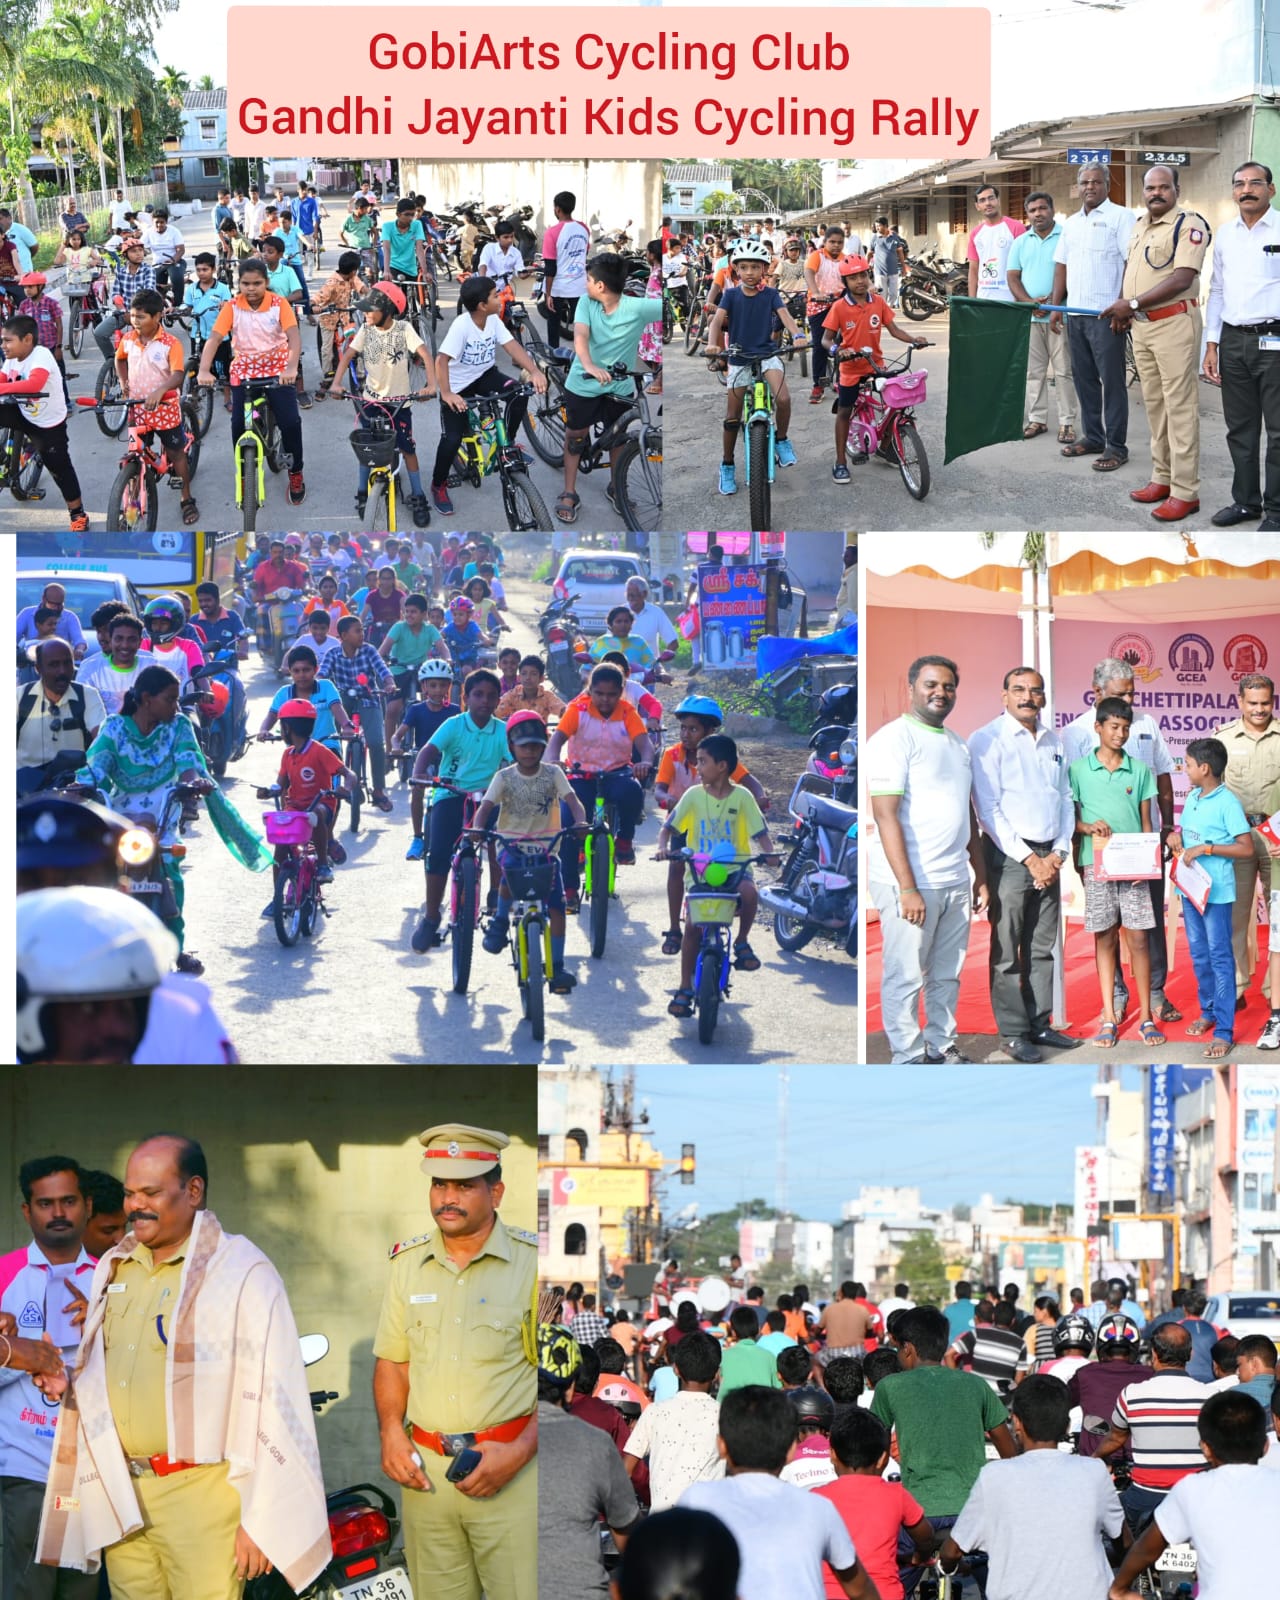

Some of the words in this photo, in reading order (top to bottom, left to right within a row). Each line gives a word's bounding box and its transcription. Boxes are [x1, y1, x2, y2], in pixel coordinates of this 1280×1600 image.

[46, 563, 86, 571] COLLEGE
[89, 564, 108, 572] BUS
[1176, 673, 1206, 682] GCEA
[795, 1469, 829, 1481] Techno
[351, 1586, 373, 1600] TN
[377, 1578, 395, 1593] 36
